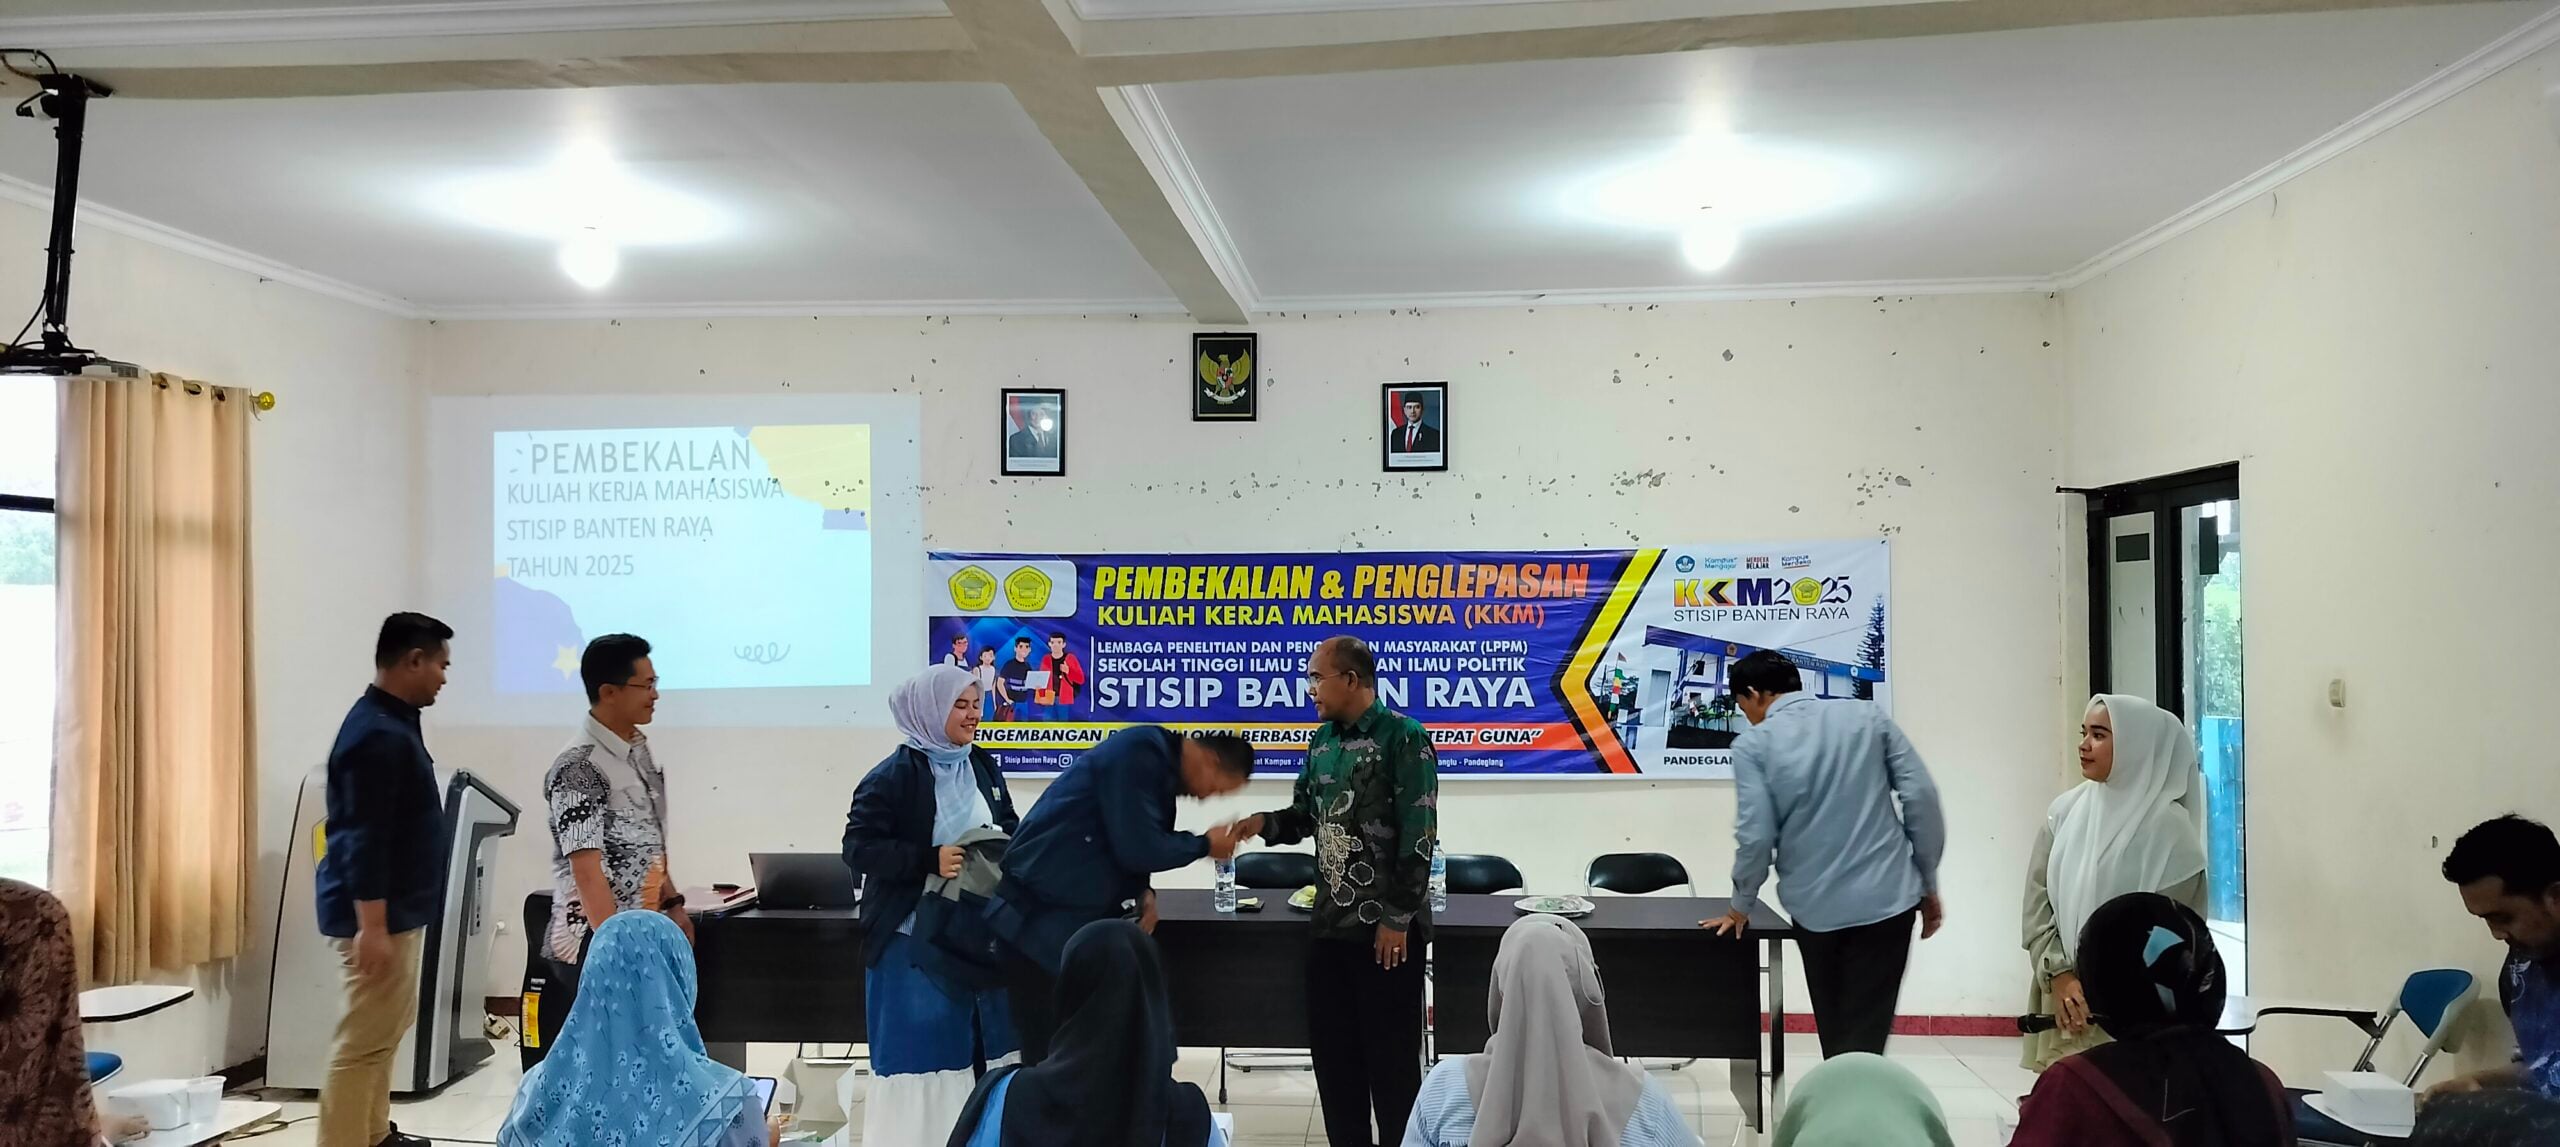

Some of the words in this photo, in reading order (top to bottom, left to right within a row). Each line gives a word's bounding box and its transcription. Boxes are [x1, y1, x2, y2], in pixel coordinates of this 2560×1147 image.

[532, 440, 751, 474] PEMBEKALAN
[507, 482, 581, 504] KULIAH
[588, 480, 647, 503] KERJA
[655, 477, 784, 501] MAHASISWA
[507, 519, 566, 541] STISIP
[573, 517, 656, 540] BANTEN
[663, 516, 713, 537] RAYA
[507, 556, 578, 578] TAHUN
[585, 554, 634, 576] 2025
[1746, 562, 1770, 570] BELAJAR
[1093, 565, 1313, 600] PEMBEKALAN
[1319, 566, 1345, 600] &
[1352, 563, 1590, 599] PENGLEPASAN
[1098, 606, 1196, 626] KULIAH
[1205, 605, 1285, 626] KERJA
[1292, 604, 1456, 625] MAHASISWA
[1464, 604, 1546, 630] (KKM)
[1673, 608, 1728, 622] STISIP
[1732, 608, 1800, 622] BANTEN
[1806, 607, 1850, 620] RAYA
[1098, 642, 1163, 654] LEMBAGA
[1168, 641, 1248, 653] PENELITIAN
[1252, 641, 1282, 653] DAN
[1384, 640, 1477, 653] MASYARAKAT
[1480, 640, 1528, 655] (LPPM)
[1098, 658, 1178, 672] SEKOLAH
[1182, 658, 1244, 672] TINGGI
[1250, 658, 1292, 672] ILMU
[1376, 658, 1401, 672] AN
[1408, 658, 1451, 672] ILMU
[1457, 657, 1525, 672] POLITIK
[1098, 677, 1222, 708] STISIP
[1239, 677, 1409, 708] BANN
[1427, 677, 1535, 708] RAYA
[973, 729, 1102, 742] ENGEMBANGAN
[1427, 730, 1474, 742] TEPAT
[1005, 755, 1020, 765] Stisip
[1022, 755, 1042, 764] Banten
[1043, 755, 1057, 766] Raya
[1265, 757, 1291, 767] Kampus
[1463, 758, 1504, 768] Pandeglang
